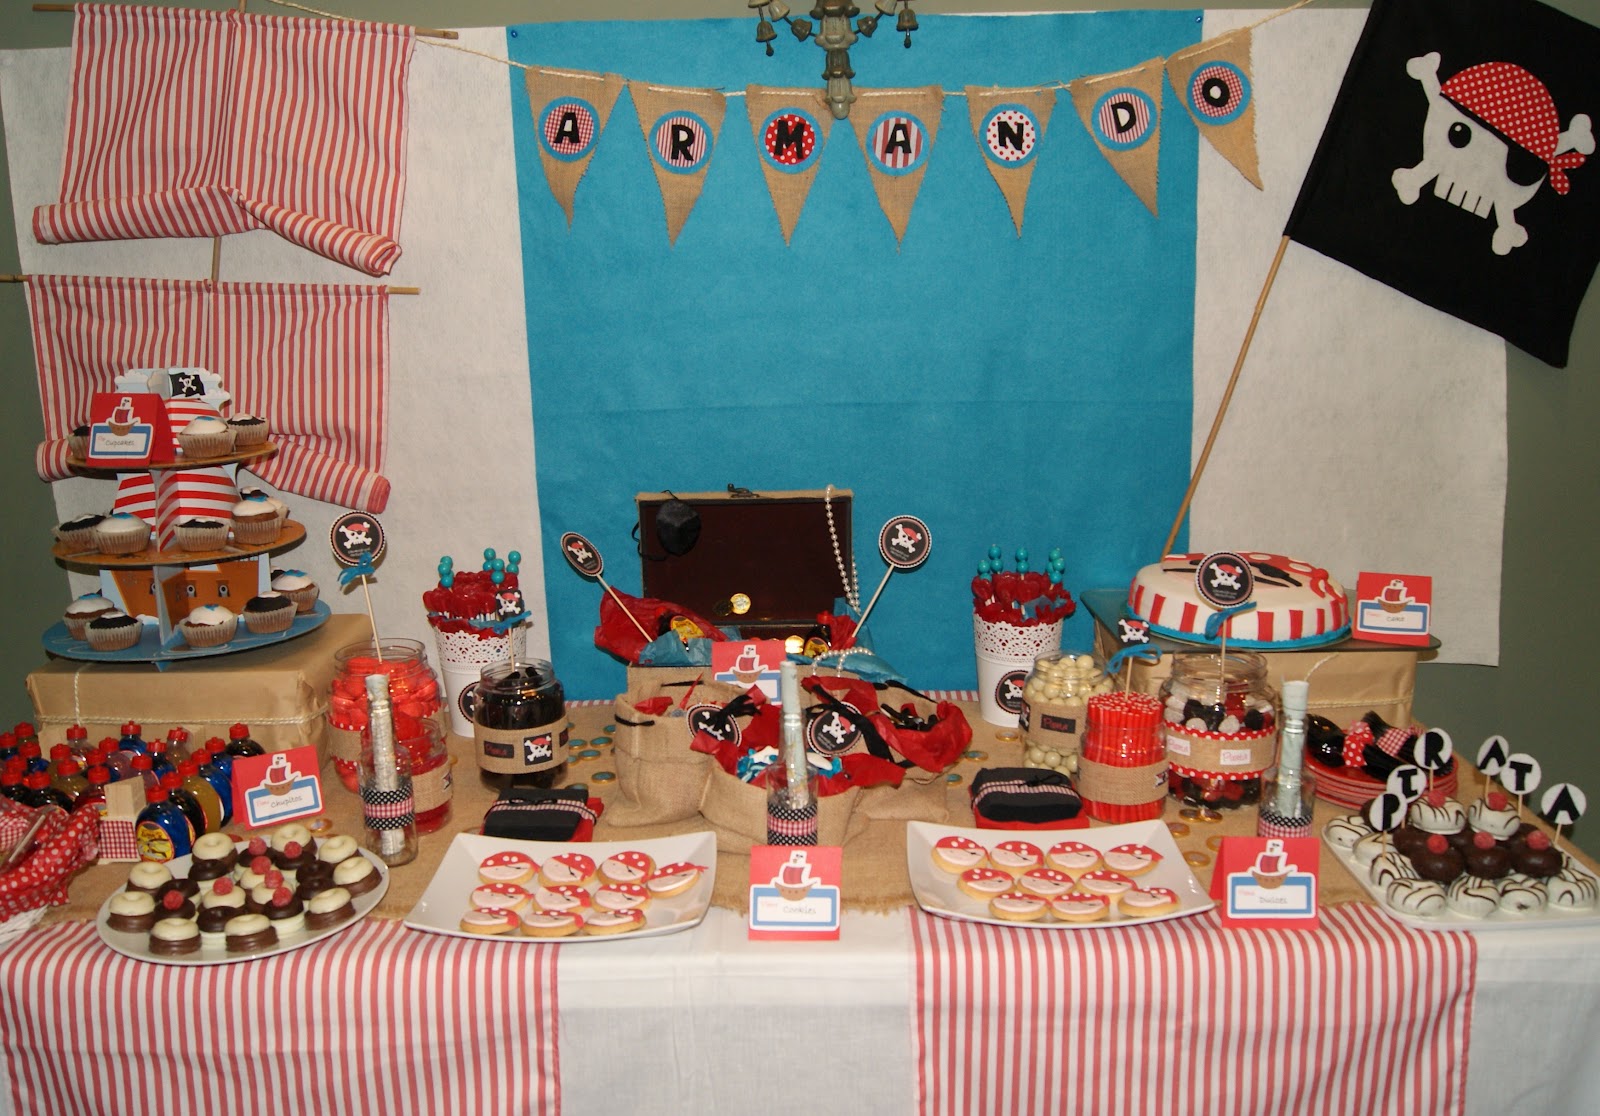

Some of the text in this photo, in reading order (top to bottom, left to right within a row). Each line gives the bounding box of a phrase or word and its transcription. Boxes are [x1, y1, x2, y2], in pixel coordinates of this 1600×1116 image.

[553, 77, 1230, 162] A R M A N D O
[1382, 731, 1581, 832] P I R A T A
